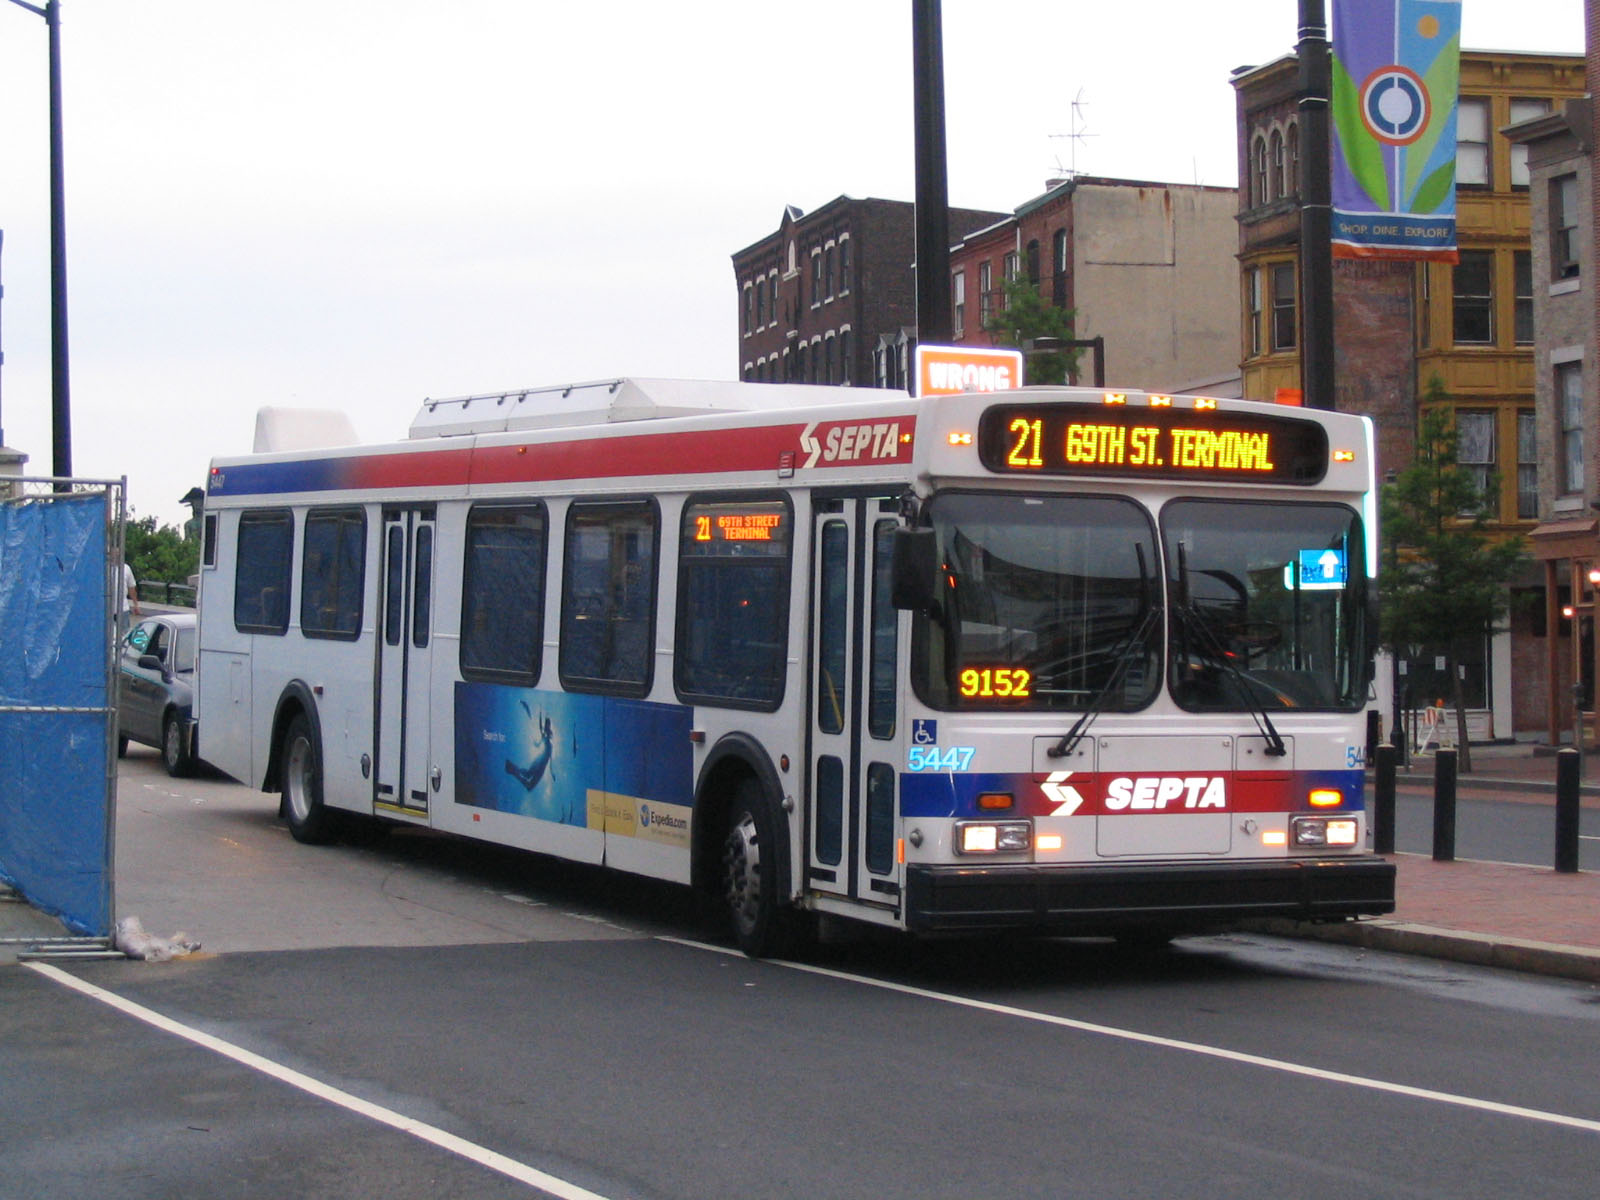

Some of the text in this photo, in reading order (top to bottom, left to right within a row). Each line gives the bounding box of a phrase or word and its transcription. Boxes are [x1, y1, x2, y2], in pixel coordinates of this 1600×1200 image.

[1404, 226, 1449, 239] EXPLORE
[928, 362, 1011, 392] WRONG
[823, 423, 900, 462] SEPTA
[1007, 418, 1274, 470] 21 69TH ST. TERMINAL
[696, 514, 780, 541] 21 69TH STREET
[724, 527, 771, 540] TERMINAL
[960, 669, 1031, 697] 9152
[908, 747, 976, 771] 5447
[1105, 777, 1227, 810] SEPTA
